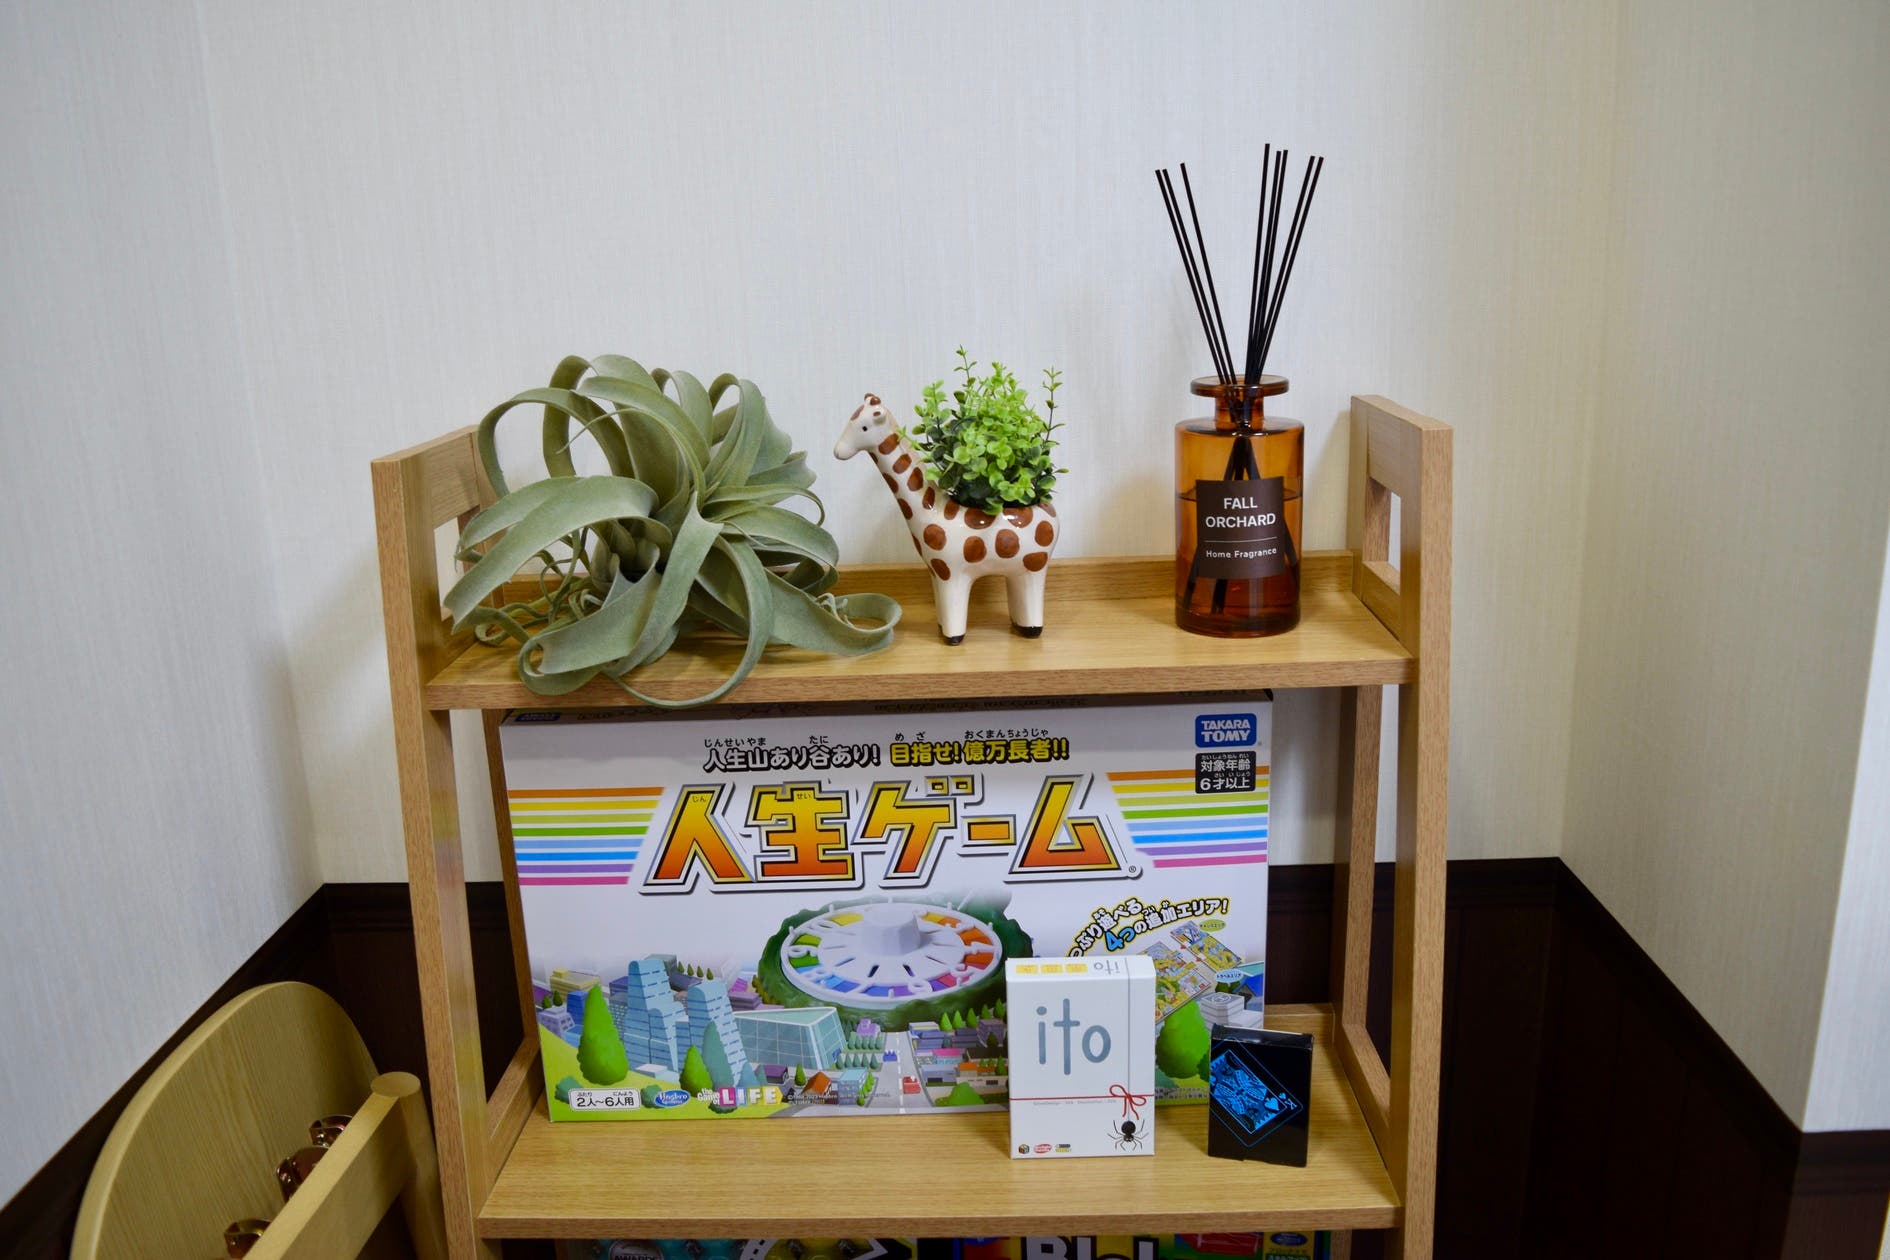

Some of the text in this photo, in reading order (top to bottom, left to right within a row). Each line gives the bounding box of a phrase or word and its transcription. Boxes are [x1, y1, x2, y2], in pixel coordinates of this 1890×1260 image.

[1223, 497, 1258, 509] FALL
[1205, 513, 1276, 528] ORCHARD
[1206, 548, 1277, 559] Home Fragrance
[1201, 719, 1251, 731] TAKARA
[704, 735, 829, 748] じんせいやま たに
[1201, 730, 1250, 743] TOMY
[703, 743, 881, 773] 人生山あり谷あり!
[1200, 758, 1251, 772] 対象年齢
[1200, 777, 1250, 790] 6才以上
[643, 774, 1130, 886] 人生ゲーム
[1036, 998, 1112, 1076] ito
[722, 1087, 778, 1106] LIFE
